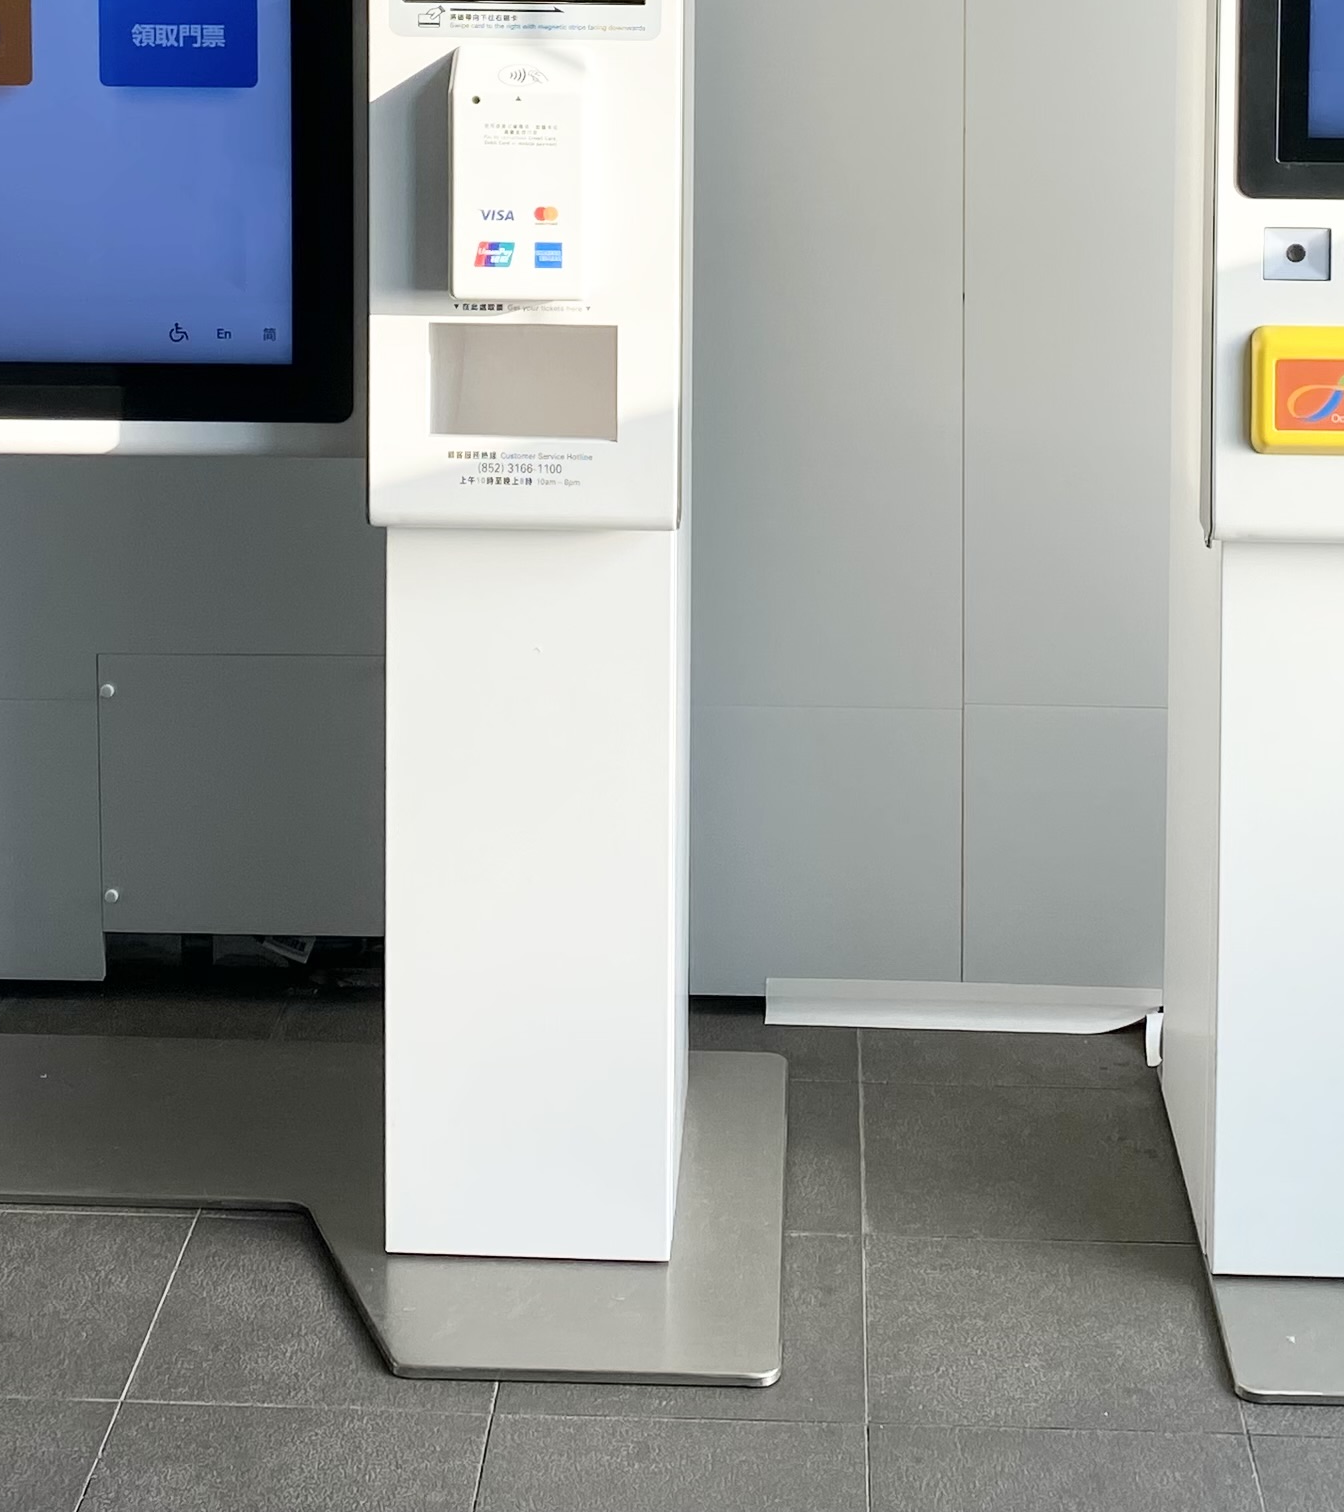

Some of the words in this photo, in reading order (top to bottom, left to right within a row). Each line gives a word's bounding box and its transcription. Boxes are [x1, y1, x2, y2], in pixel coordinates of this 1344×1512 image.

[131, 23, 226, 48] 領取門票
[479, 209, 515, 221] VISA
[216, 328, 232, 340] En
[500, 451, 536, 460] Customer
[537, 452, 565, 461] Service
[566, 453, 593, 461] Hotline
[477, 462, 505, 474] (852)
